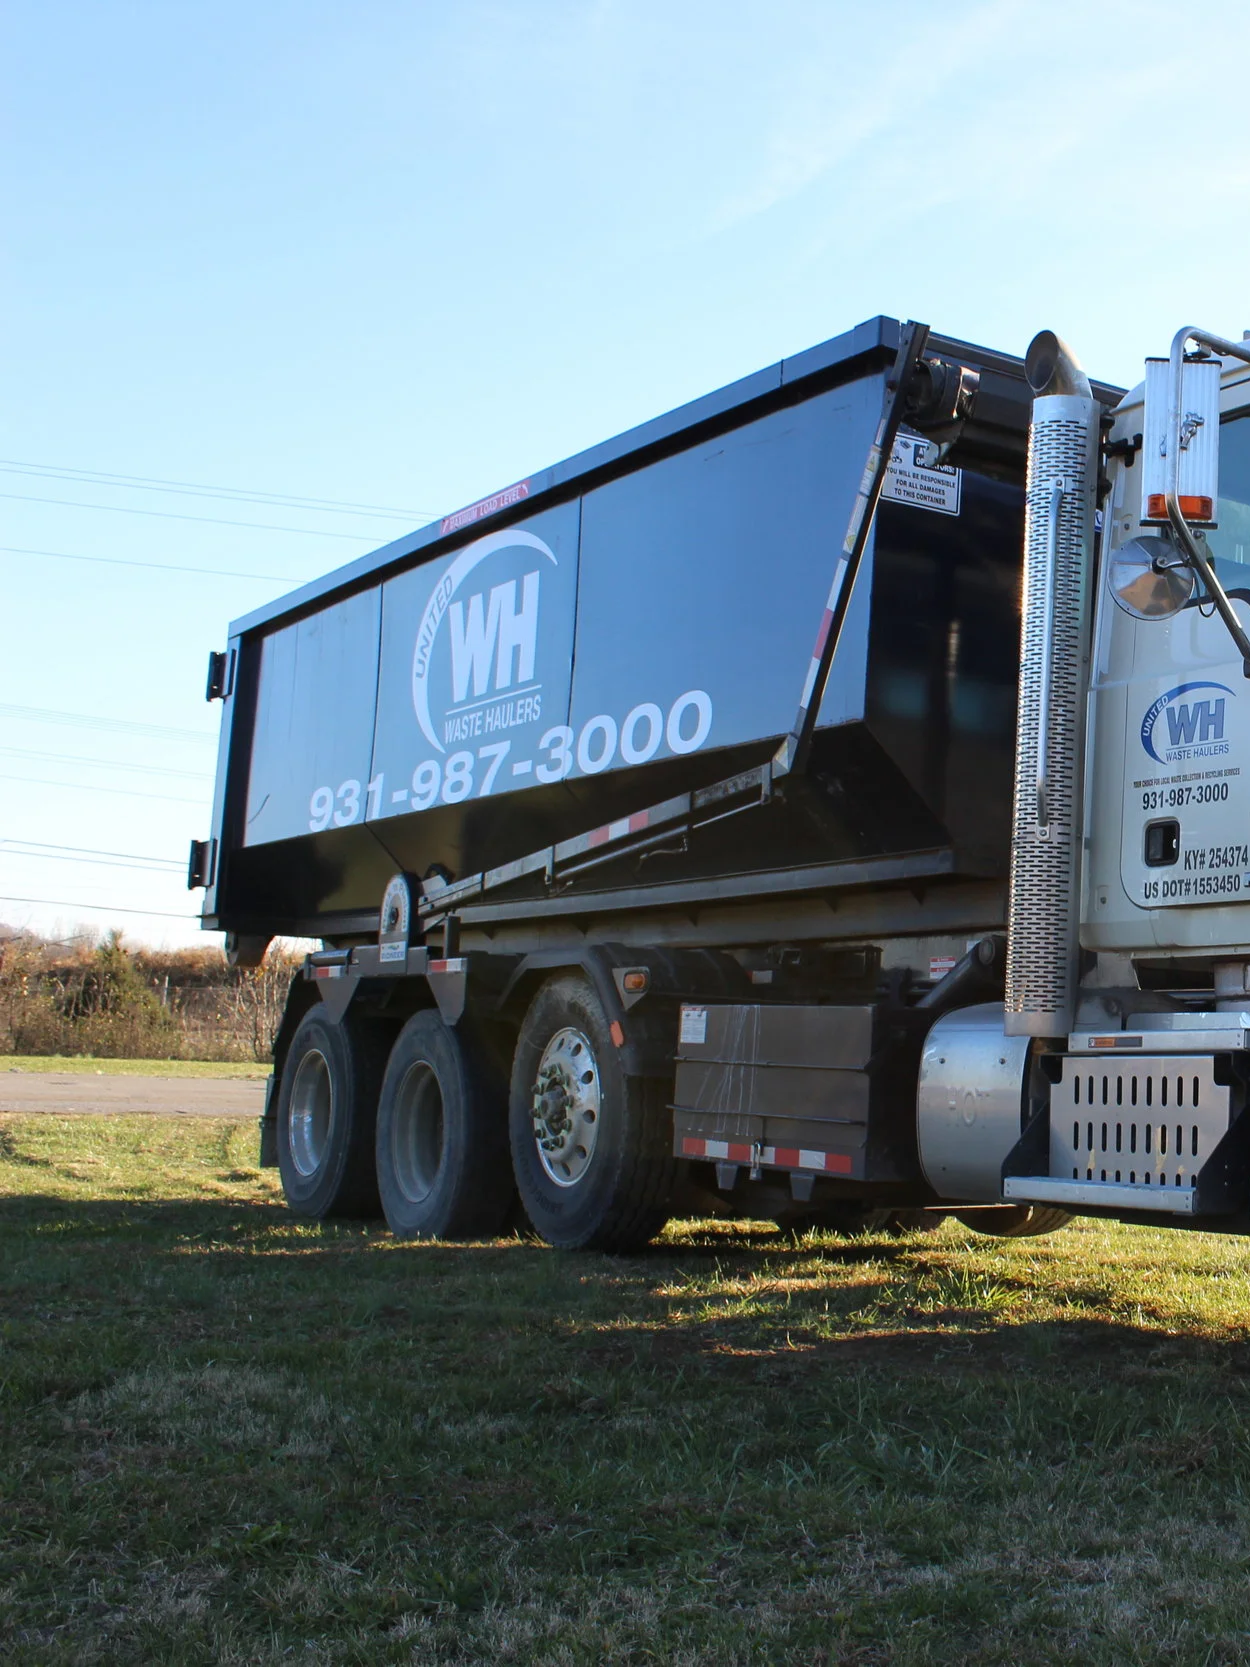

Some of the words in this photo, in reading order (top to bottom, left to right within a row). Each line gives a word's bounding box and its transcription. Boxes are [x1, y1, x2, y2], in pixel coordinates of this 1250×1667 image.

[896, 479, 908, 487] FOR
[909, 482, 918, 490] ALL
[920, 484, 945, 496] DAMAGES
[899, 470, 911, 478] WILL
[921, 474, 956, 488] RESPONSIBLE
[480, 499, 498, 516] LOAD
[500, 487, 520, 507] LEVEL
[894, 487, 902, 495] TO
[903, 489, 915, 499] THIS
[916, 493, 946, 505] CONTAINER
[415, 574, 453, 679] UNITED
[450, 570, 540, 703] WH
[444, 711, 483, 744] WASTE
[485, 694, 542, 733] HAULERS
[1142, 695, 1169, 737] UNITED
[1166, 698, 1225, 746] WH
[309, 690, 713, 833] 931-987-3000
[1166, 749, 1192, 762] WASTE
[1193, 744, 1230, 757] HAULERS
[1161, 777, 1170, 785] LOCAL
[1182, 772, 1201, 782] COLLECTION
[1205, 769, 1223, 779] RECYCLING
[1223, 767, 1240, 777] SERVICES
[1142, 782, 1229, 810] 931-987-3000
[1184, 849, 1206, 871] KY#
[1208, 845, 1249, 869] 254374
[1144, 880, 1159, 899] US
